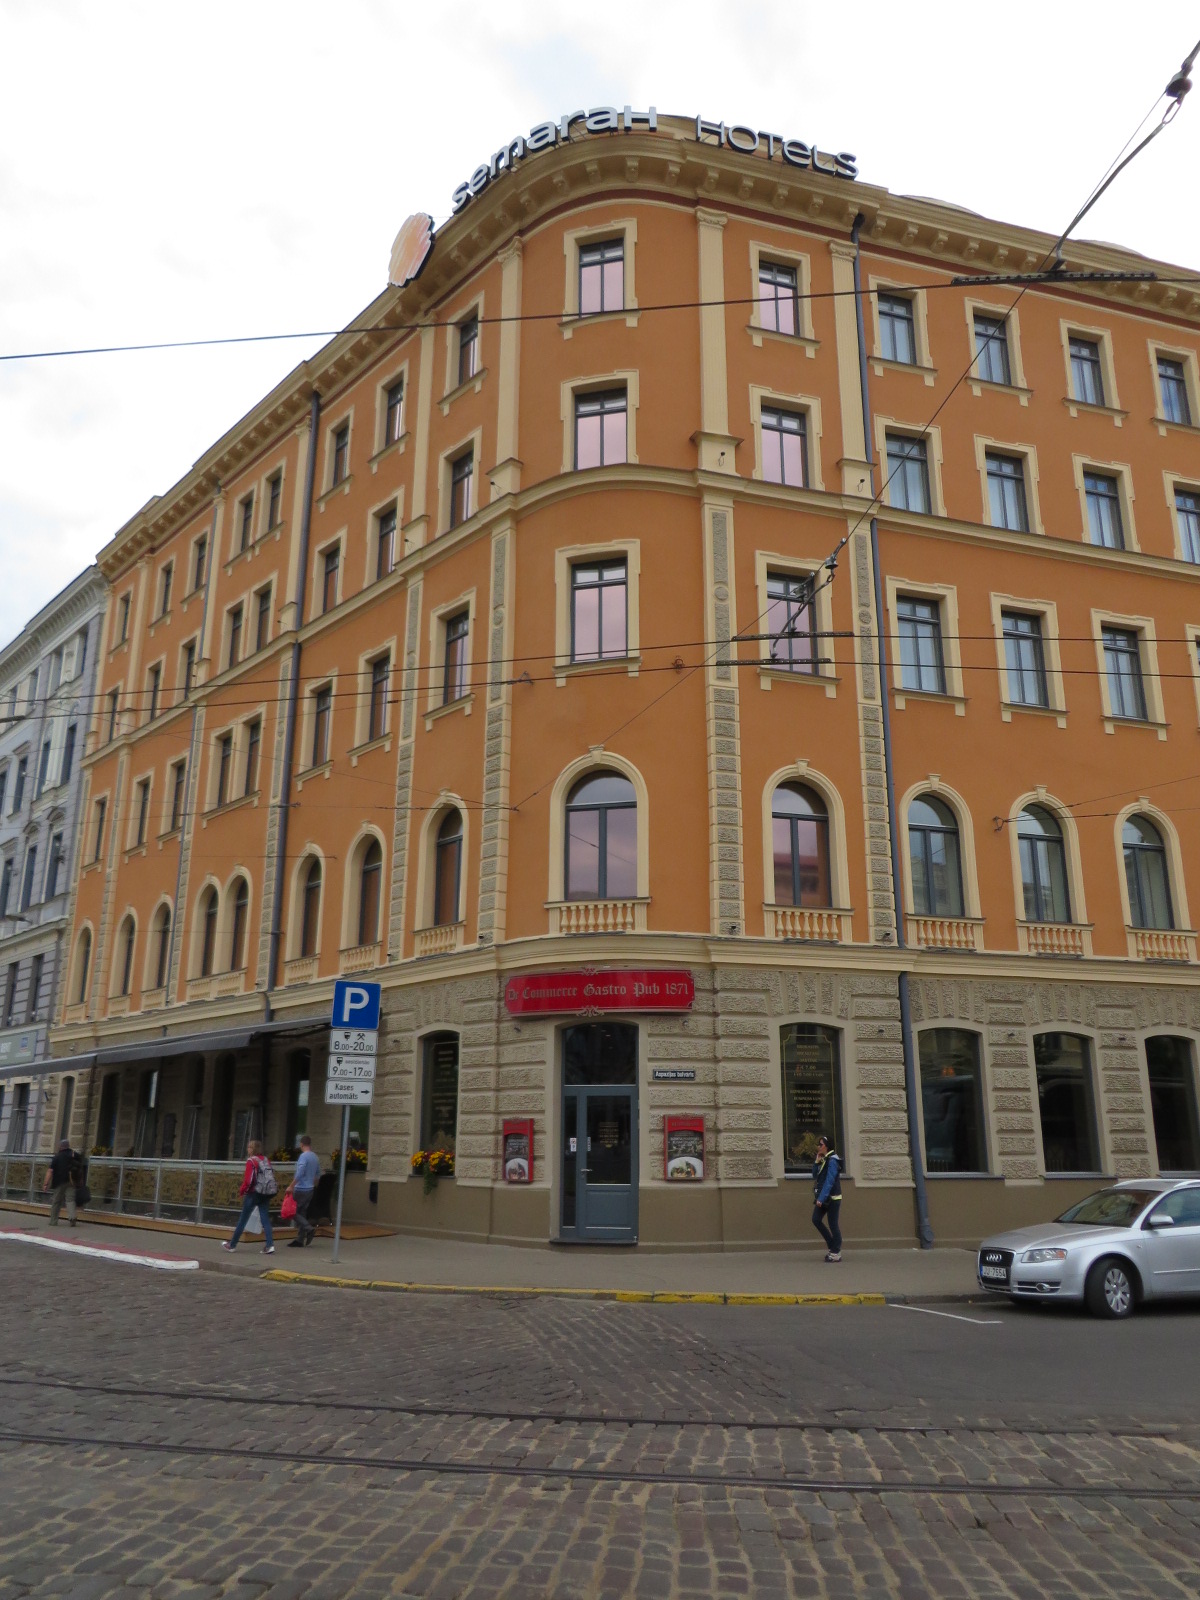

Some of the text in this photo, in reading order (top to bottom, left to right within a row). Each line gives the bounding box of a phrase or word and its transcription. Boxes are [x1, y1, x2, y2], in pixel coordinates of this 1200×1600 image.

[523, 986, 578, 1000] Commerce
[583, 983, 627, 996] Gastro
[633, 982, 660, 997] Pub
[665, 983, 689, 995] 1871
[342, 987, 370, 1022] P
[335, 1083, 354, 1091] Kases
